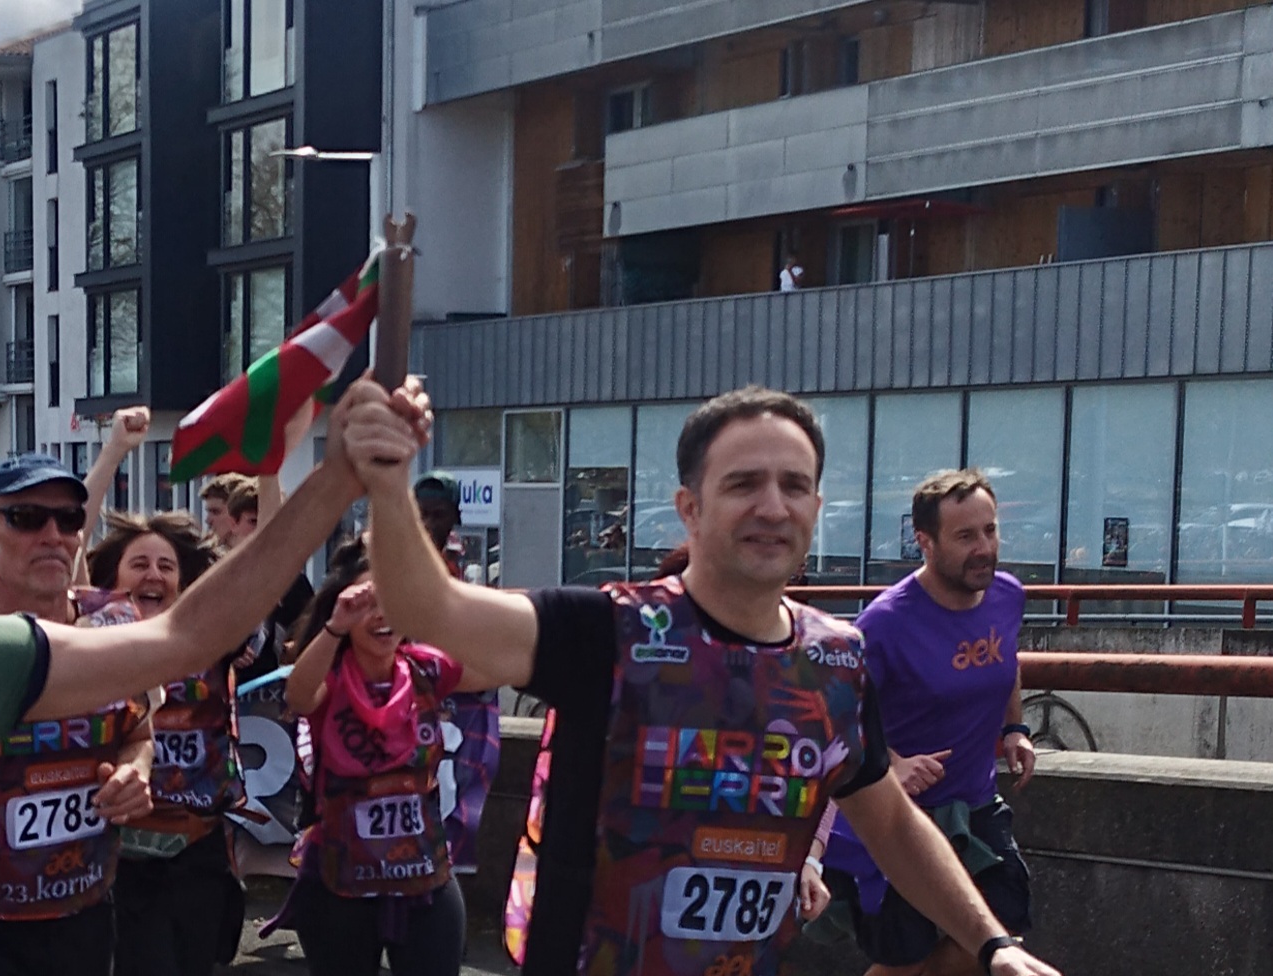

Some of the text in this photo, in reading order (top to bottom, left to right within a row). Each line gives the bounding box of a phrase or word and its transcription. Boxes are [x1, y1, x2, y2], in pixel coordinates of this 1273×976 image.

[826, 651, 861, 669] eitb
[951, 626, 1004, 670] aek
[636, 726, 823, 777] HARRO
[631, 766, 820, 818] HERRI
[701, 836, 783, 857] euskaltel
[678, 873, 784, 935] 2785
